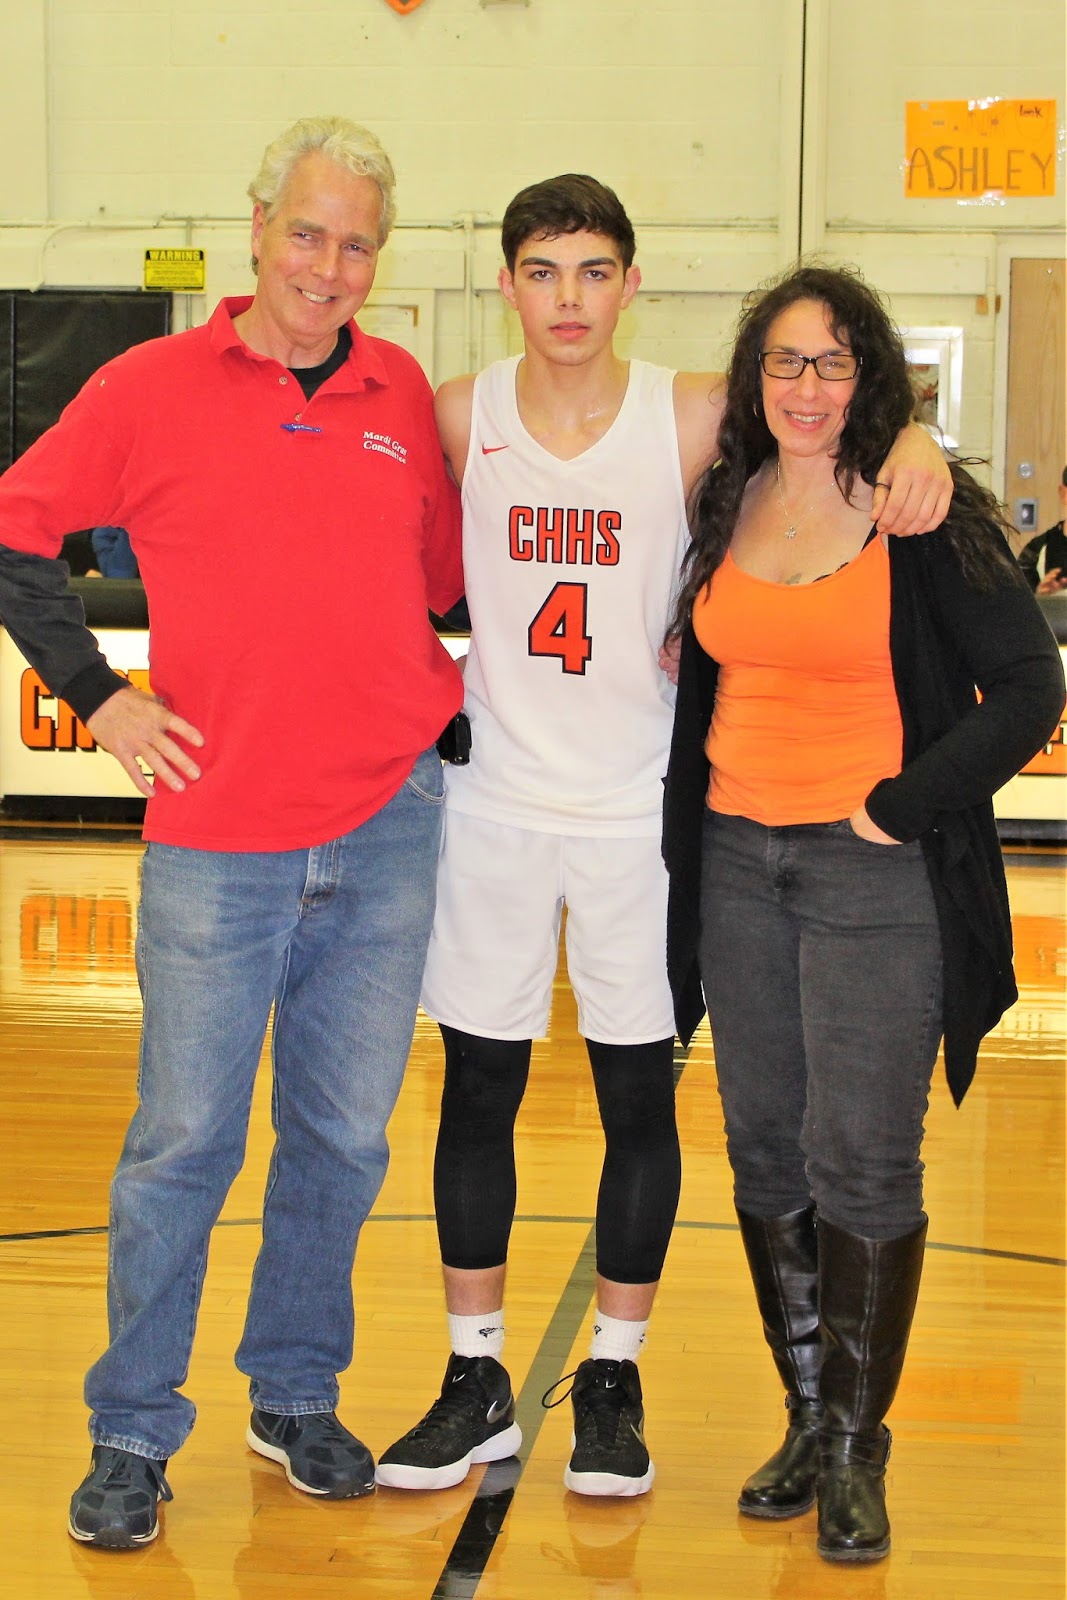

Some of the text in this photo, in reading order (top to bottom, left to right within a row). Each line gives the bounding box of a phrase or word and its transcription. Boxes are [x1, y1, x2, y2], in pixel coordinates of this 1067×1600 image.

[907, 146, 1053, 191] ASHLEY
[150, 250, 200, 261] WARNING
[363, 431, 407, 456] Mardi Gras
[363, 440, 407, 464] Committee
[509, 505, 621, 566] CHHS
[528, 581, 592, 676] 4
